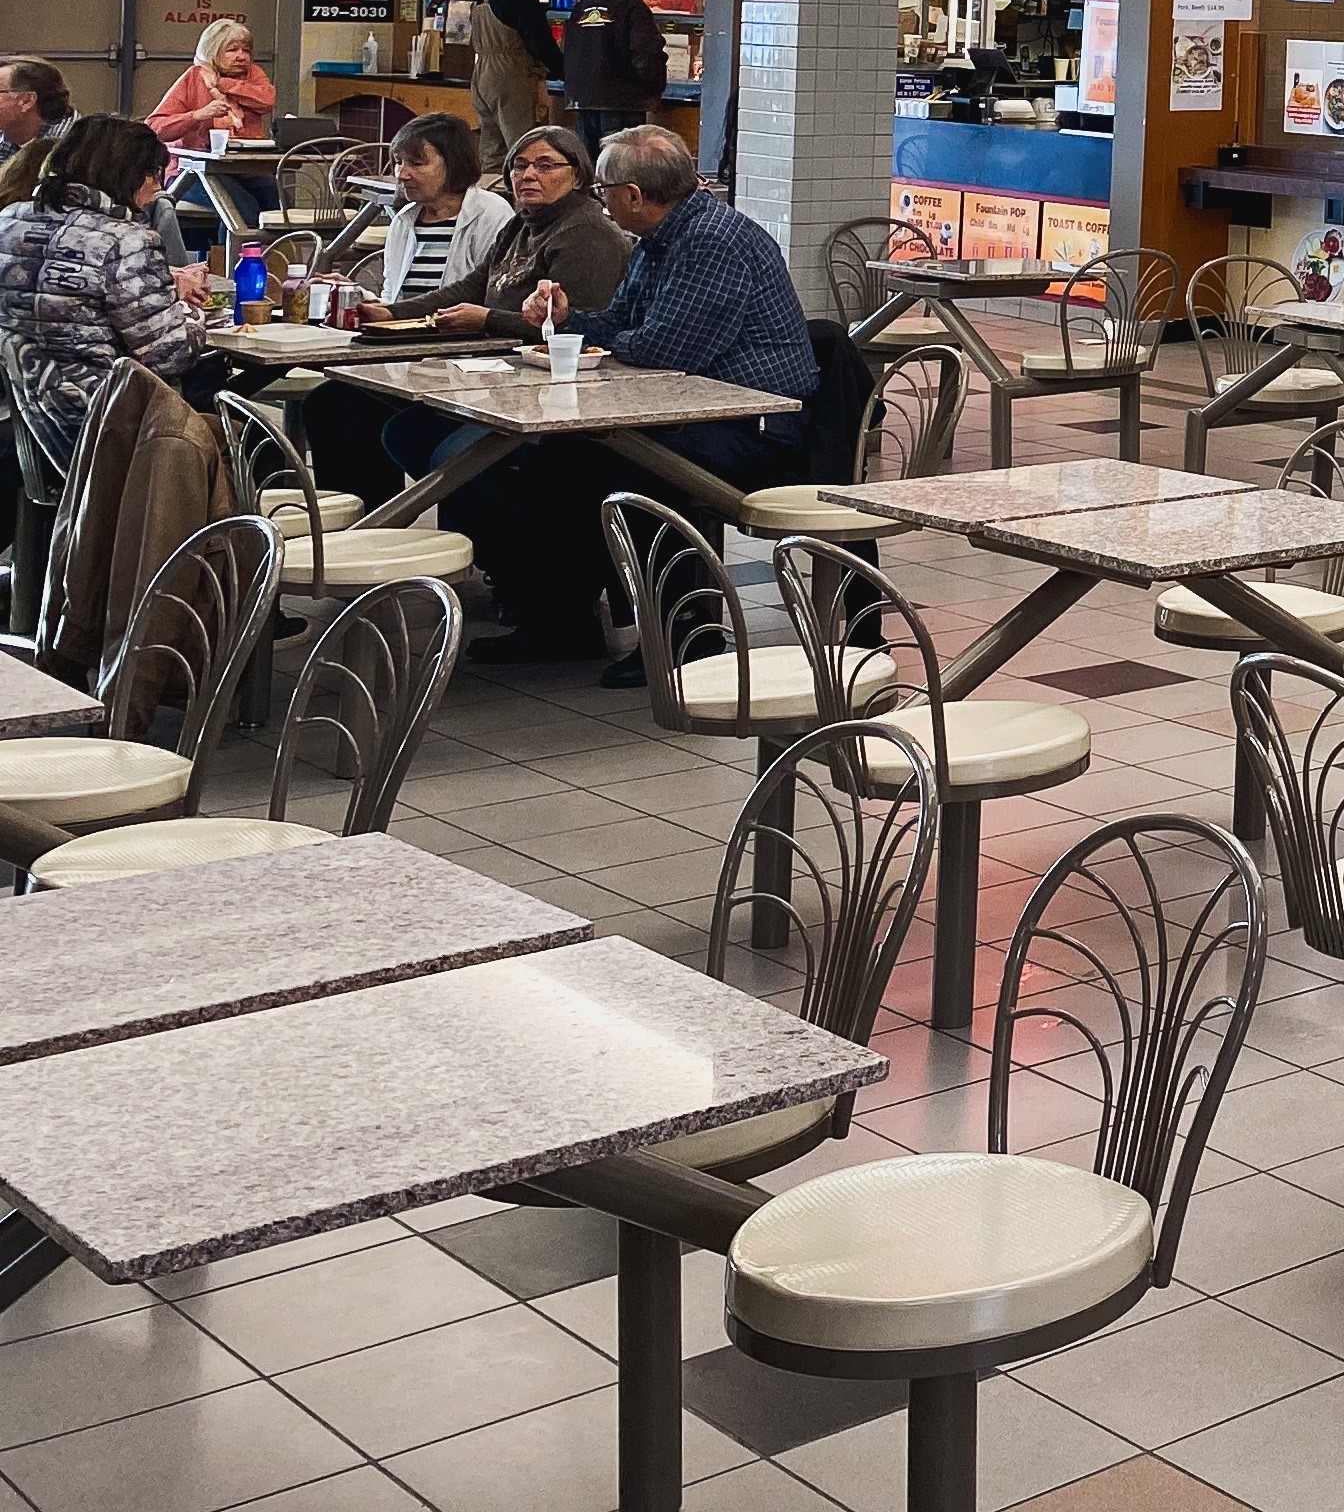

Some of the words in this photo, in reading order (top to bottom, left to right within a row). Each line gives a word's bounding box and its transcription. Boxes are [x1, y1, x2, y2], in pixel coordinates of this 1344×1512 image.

[914, 195, 942, 207] COFFEE
[976, 203, 1008, 215] Fountain
[1010, 207, 1026, 217] POP
[1048, 217, 1075, 229] TOAST
[1086, 222, 1110, 235] COFF
[910, 242, 953, 258] CHOCLATE
